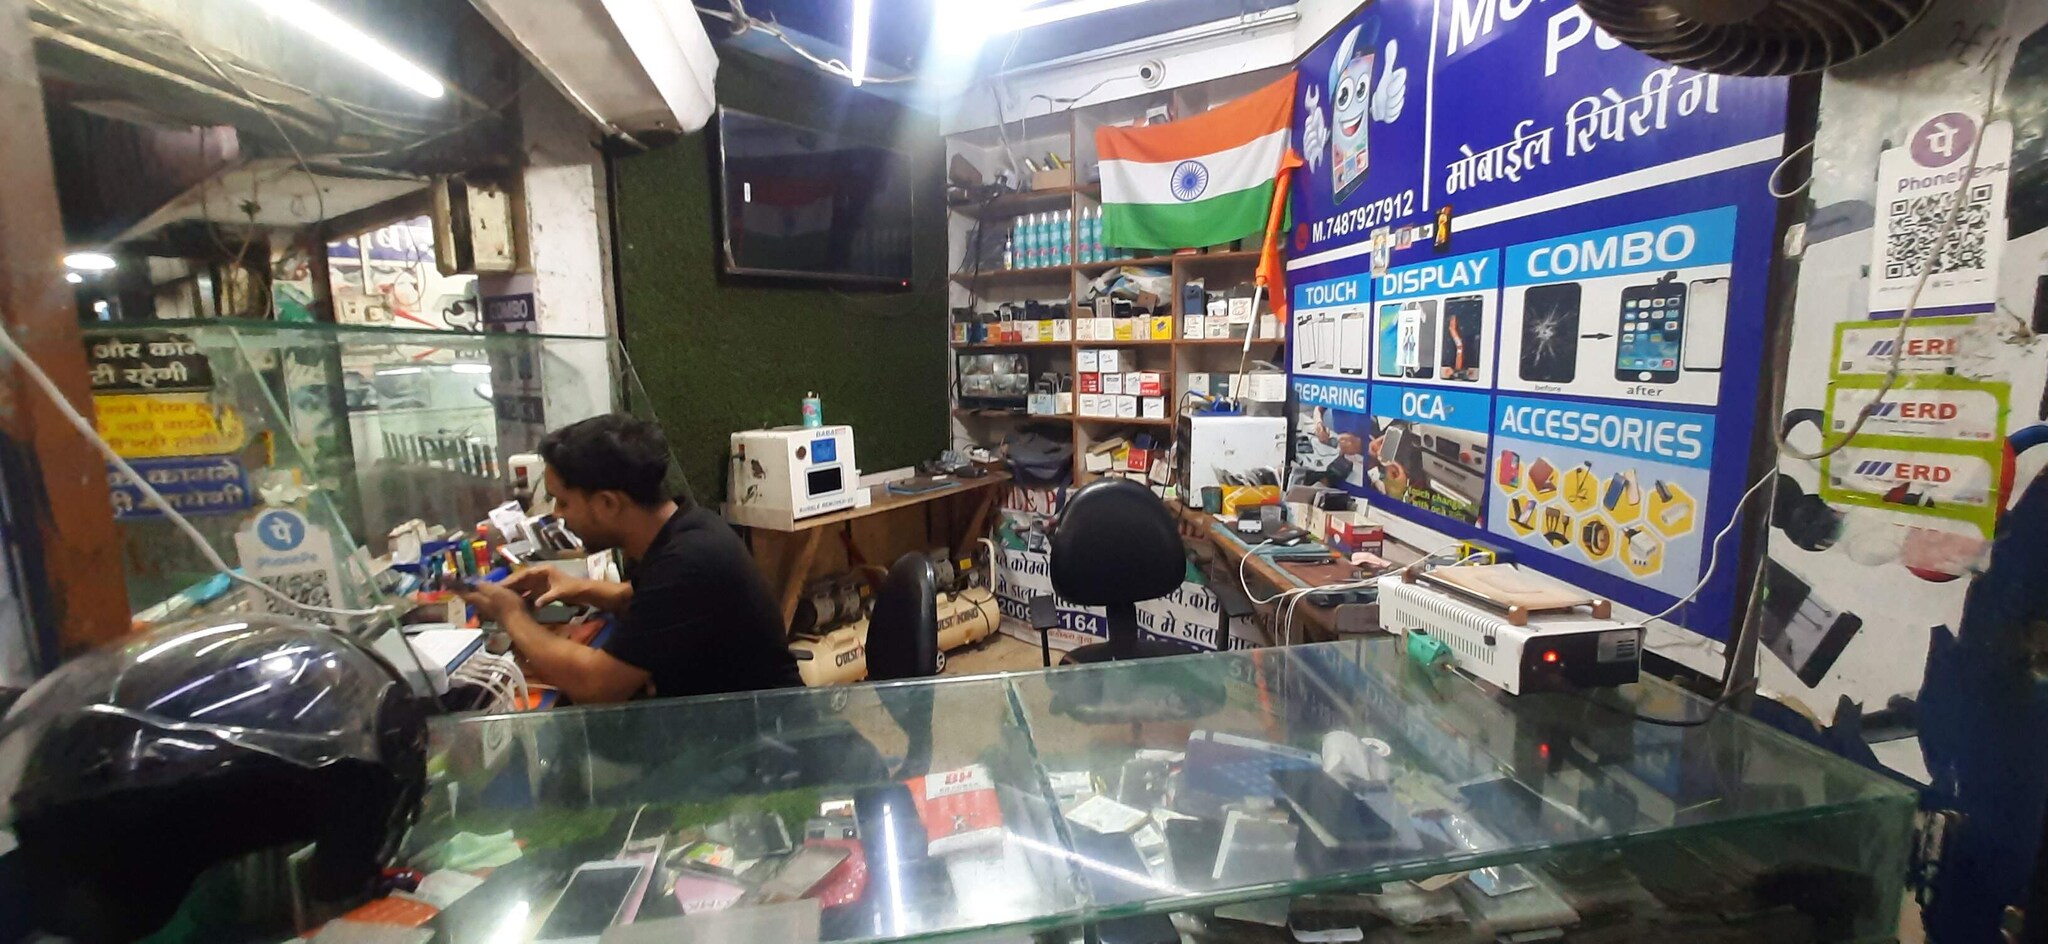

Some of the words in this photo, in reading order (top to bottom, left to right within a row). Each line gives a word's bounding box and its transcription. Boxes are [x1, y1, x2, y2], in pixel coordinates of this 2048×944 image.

[1446, 120, 1554, 194] मोबाईल
[1312, 189, 1414, 243] M.7487927912
[1527, 225, 1696, 277] COMBO
[1383, 256, 1488, 296] DISPLAY
[1305, 280, 1357, 306] TOUCH
[1294, 383, 1366, 409] REPARING
[1626, 385, 1663, 397] after
[1402, 392, 1446, 421] OCA
[1900, 402, 1957, 420] ERD
[1501, 405, 1702, 460] ACCESSORIES
[1895, 463, 1951, 483] ERD
[1057, 611, 1098, 634] 164
